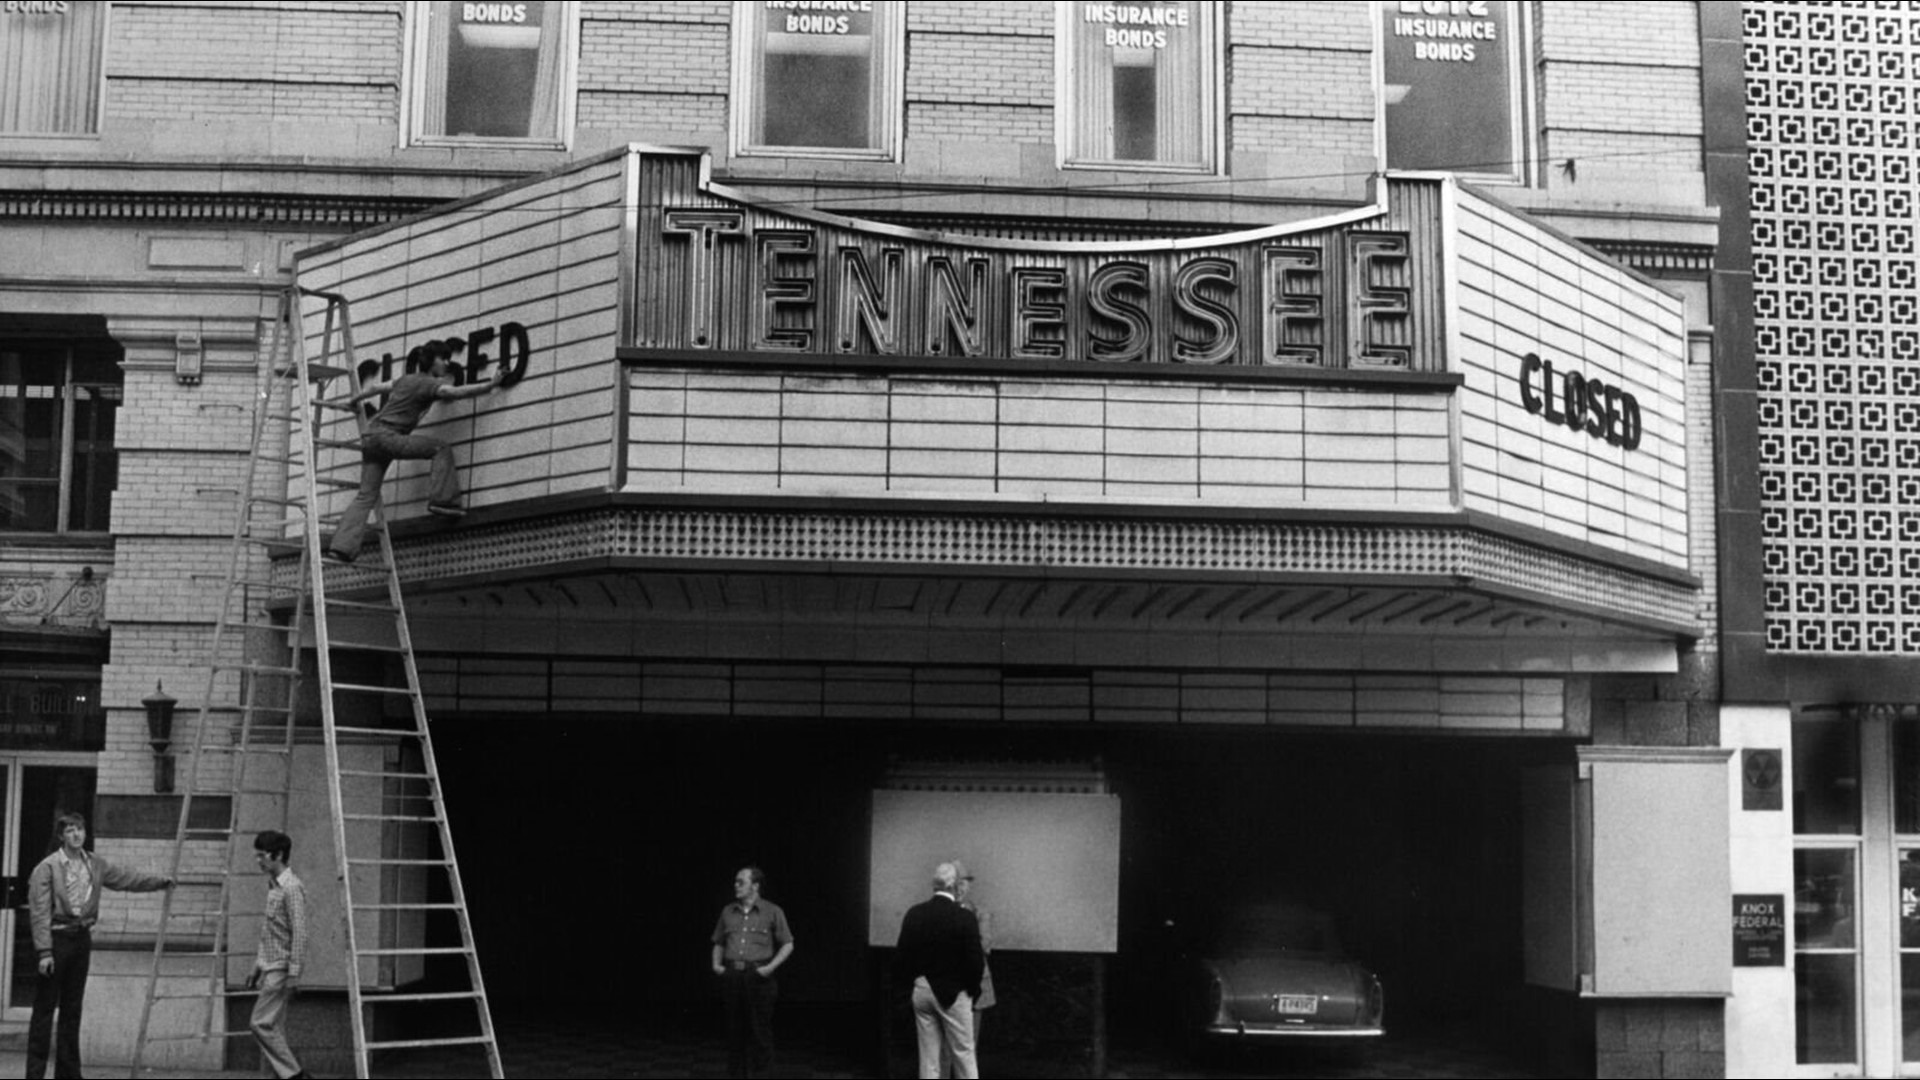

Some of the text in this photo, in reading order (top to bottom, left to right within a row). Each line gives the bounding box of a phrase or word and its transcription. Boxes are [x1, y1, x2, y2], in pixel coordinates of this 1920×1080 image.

[463, 3, 527, 22] BONDS
[1085, 4, 1188, 26] INSURANCE
[786, 14, 849, 33] BONDS
[1395, 18, 1497, 40] INSURANCE
[1105, 28, 1167, 48] BONDS
[1415, 41, 1476, 62] BONDS
[662, 205, 1411, 370] TENNESSEE
[1520, 352, 1641, 451] CLOSED
[1741, 903, 1775, 915] KNOX
[1732, 915, 1784, 928] FEDERAL
